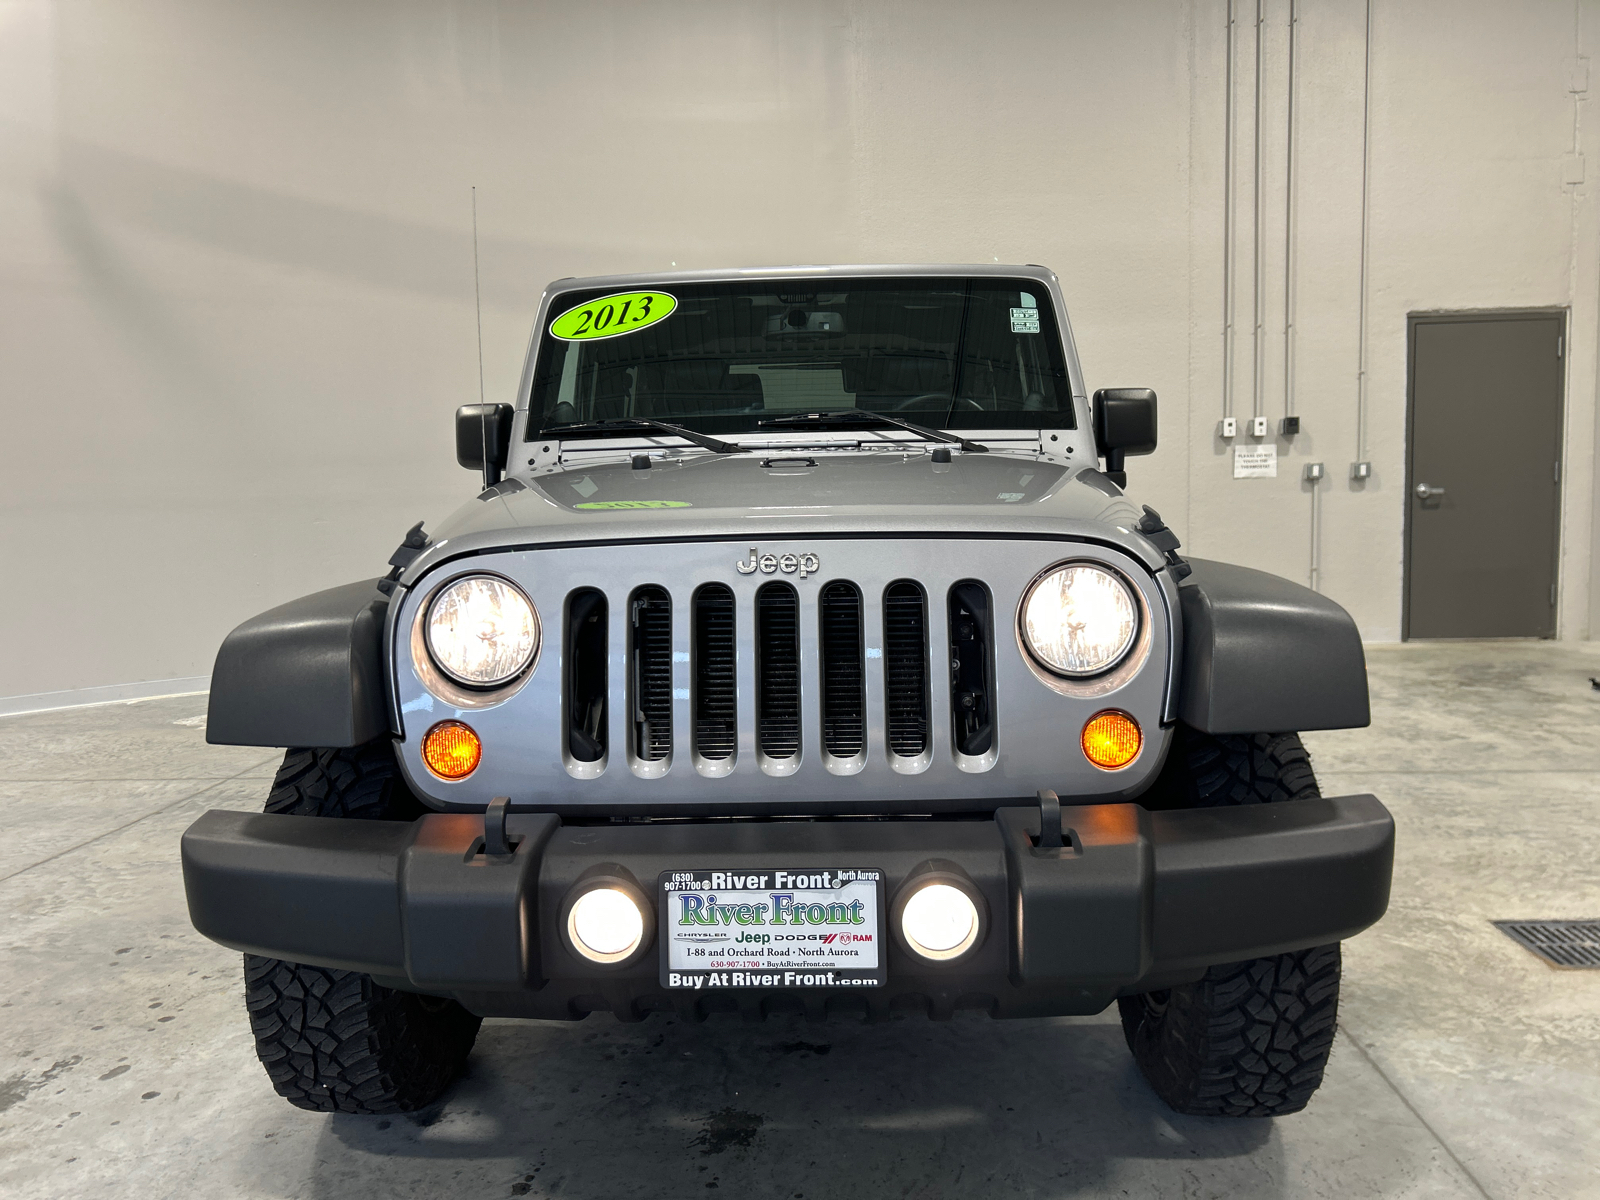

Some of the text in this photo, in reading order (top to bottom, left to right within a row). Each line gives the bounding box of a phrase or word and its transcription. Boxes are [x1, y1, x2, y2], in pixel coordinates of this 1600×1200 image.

[572, 296, 654, 336] 2013
[736, 547, 820, 579] Jeep
[672, 873, 694, 882] (630)
[711, 871, 832, 890] River Front
[837, 870, 880, 881] North Aurora
[664, 882, 701, 891] 907-1700
[678, 893, 866, 926] River Front
[735, 931, 771, 945] Jeep
[852, 934, 873, 942] RAM
[686, 947, 859, 957] I-88 and Orchard Road North Aurora
[710, 960, 836, 969] 630-907-1700 BuyAtRiverFront.com
[669, 971, 878, 990] Buy At River Front.com
